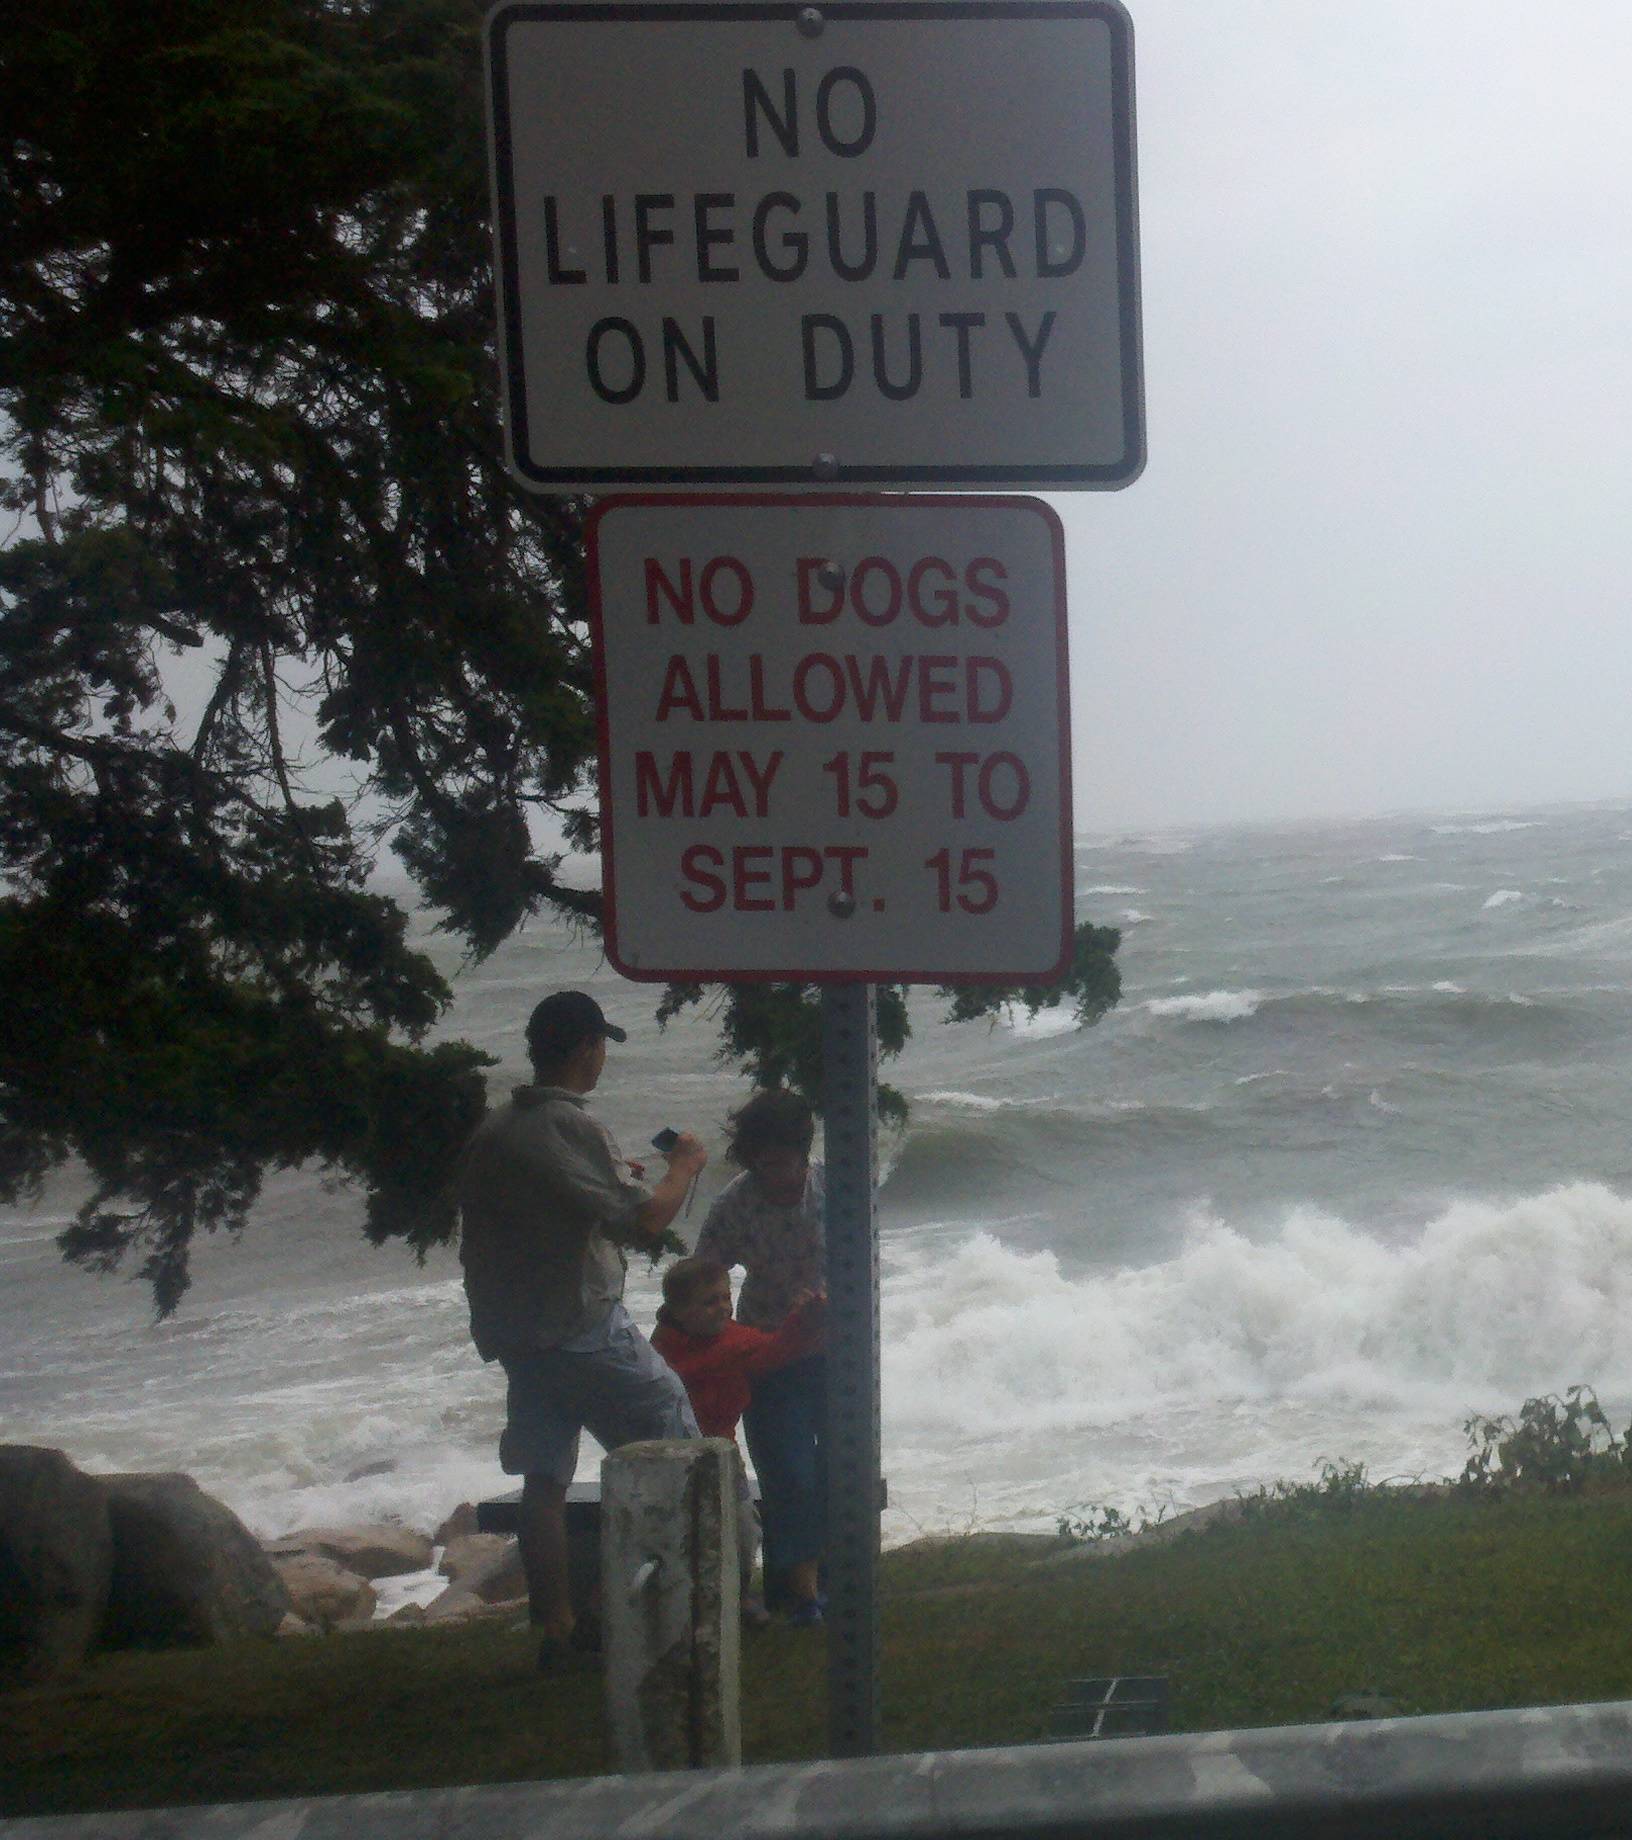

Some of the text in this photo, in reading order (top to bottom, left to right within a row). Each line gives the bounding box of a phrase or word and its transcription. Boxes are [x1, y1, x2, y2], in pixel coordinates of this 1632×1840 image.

[742, 65, 878, 159] NO
[543, 187, 1087, 286] LIFEGUARD
[585, 310, 1057, 405] ON DUTY
[643, 555, 1012, 628] NO DOGS
[655, 652, 1014, 725] ALLOWED
[634, 750, 1032, 822] MAY 15 TO
[679, 844, 1000, 915] SEPT. 15
